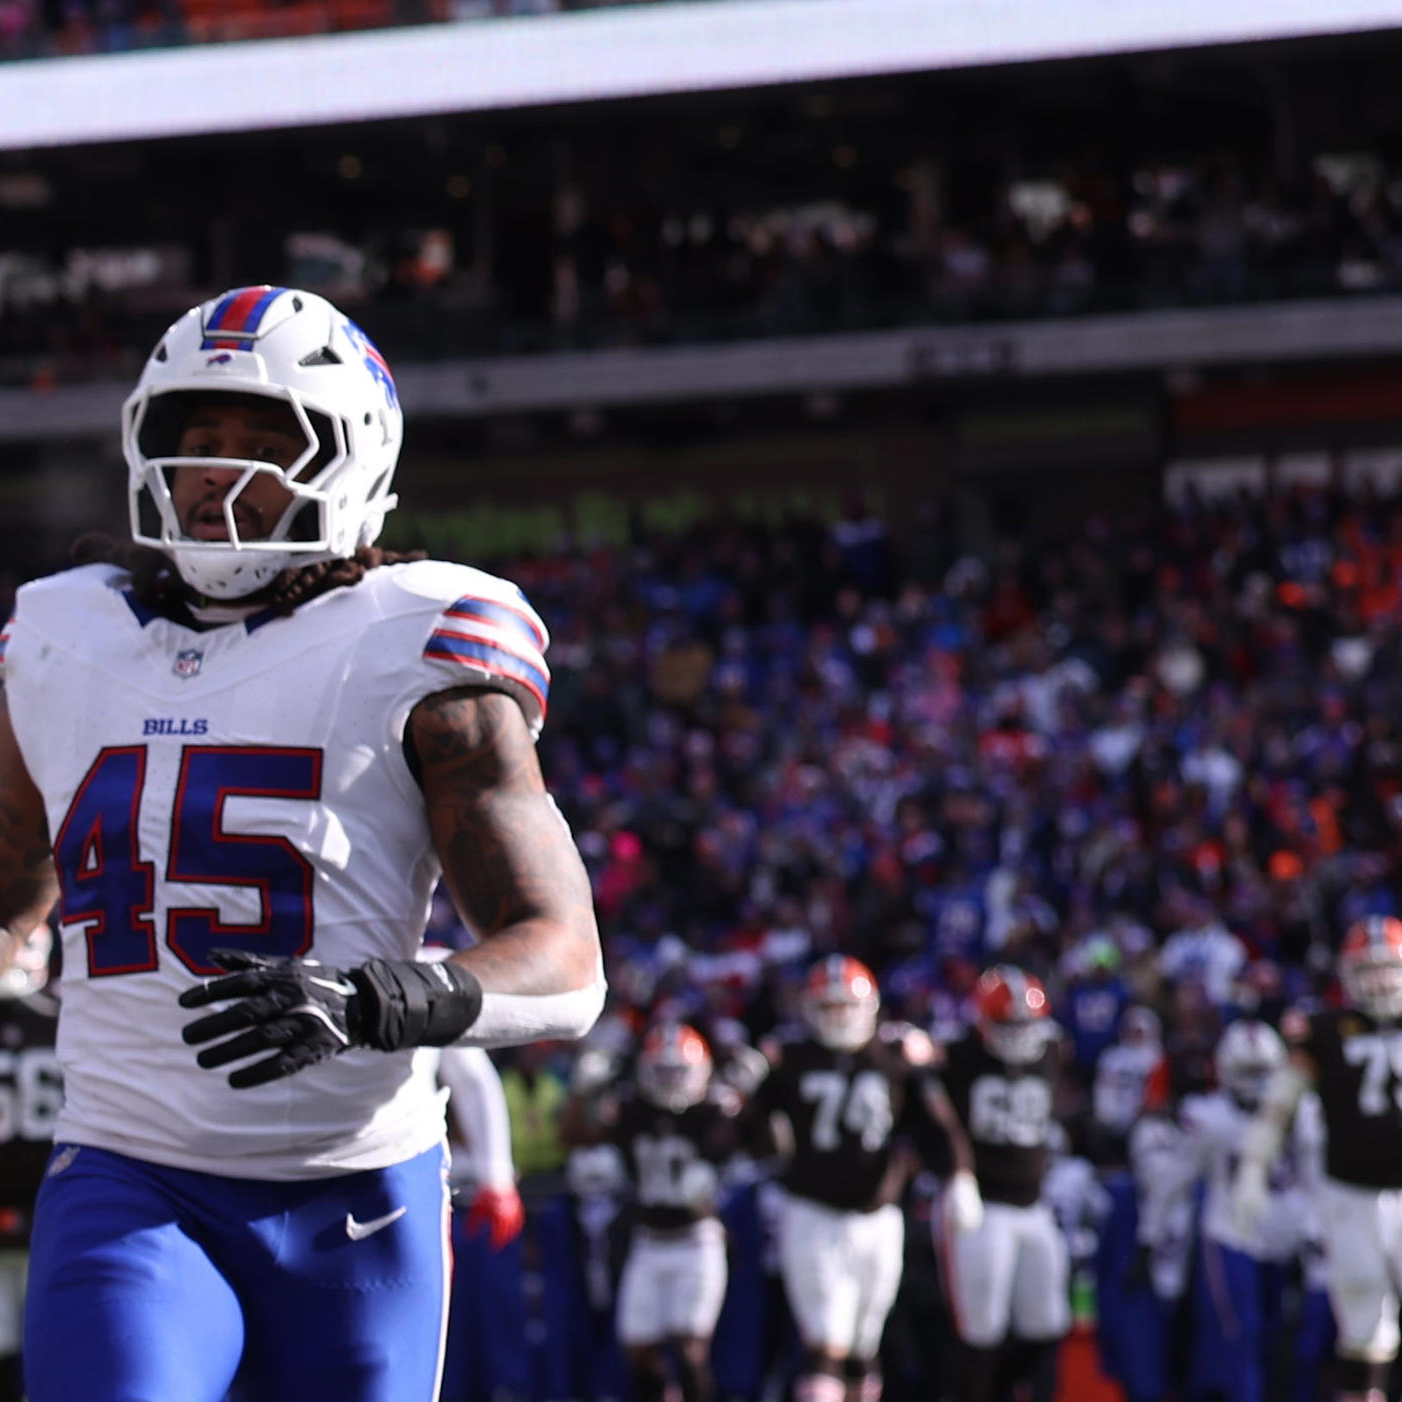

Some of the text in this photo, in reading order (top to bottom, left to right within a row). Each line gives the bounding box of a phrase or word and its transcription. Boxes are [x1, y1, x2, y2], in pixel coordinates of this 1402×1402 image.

[142, 718, 209, 736] BILLS
[53, 744, 323, 979] 45
[799, 1069, 894, 1152] 74
